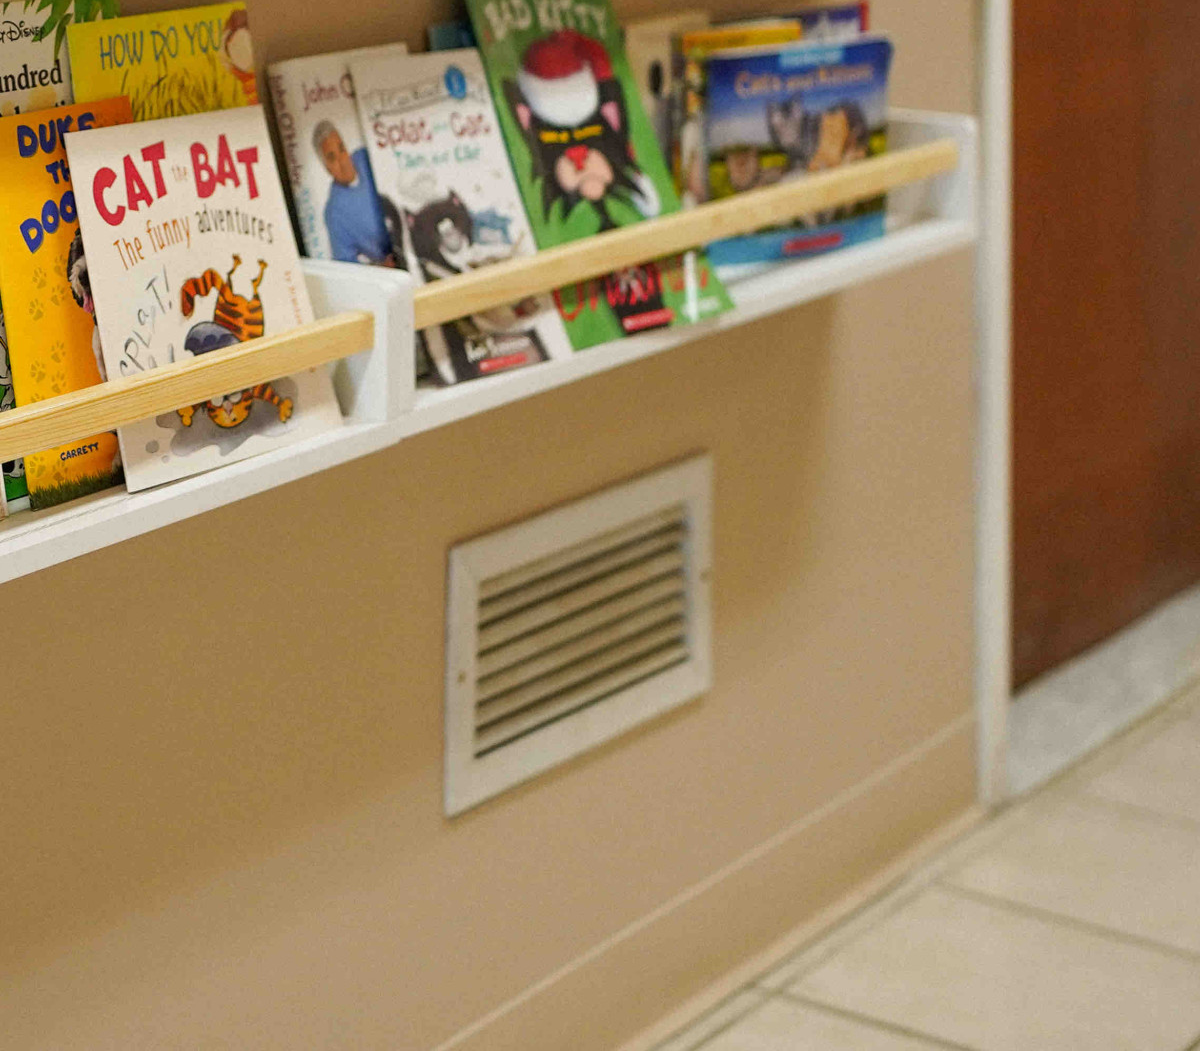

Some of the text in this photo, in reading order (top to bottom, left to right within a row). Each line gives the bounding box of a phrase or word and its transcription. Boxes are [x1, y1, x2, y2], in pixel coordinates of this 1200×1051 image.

[2, 20, 47, 43] Disney
[100, 18, 224, 70] HOW DO YOU
[92, 140, 168, 227] CAT
[190, 134, 260, 200] BAT
[113, 237, 145, 271] The
[146, 218, 191, 253] funny
[195, 204, 274, 245] adventures
